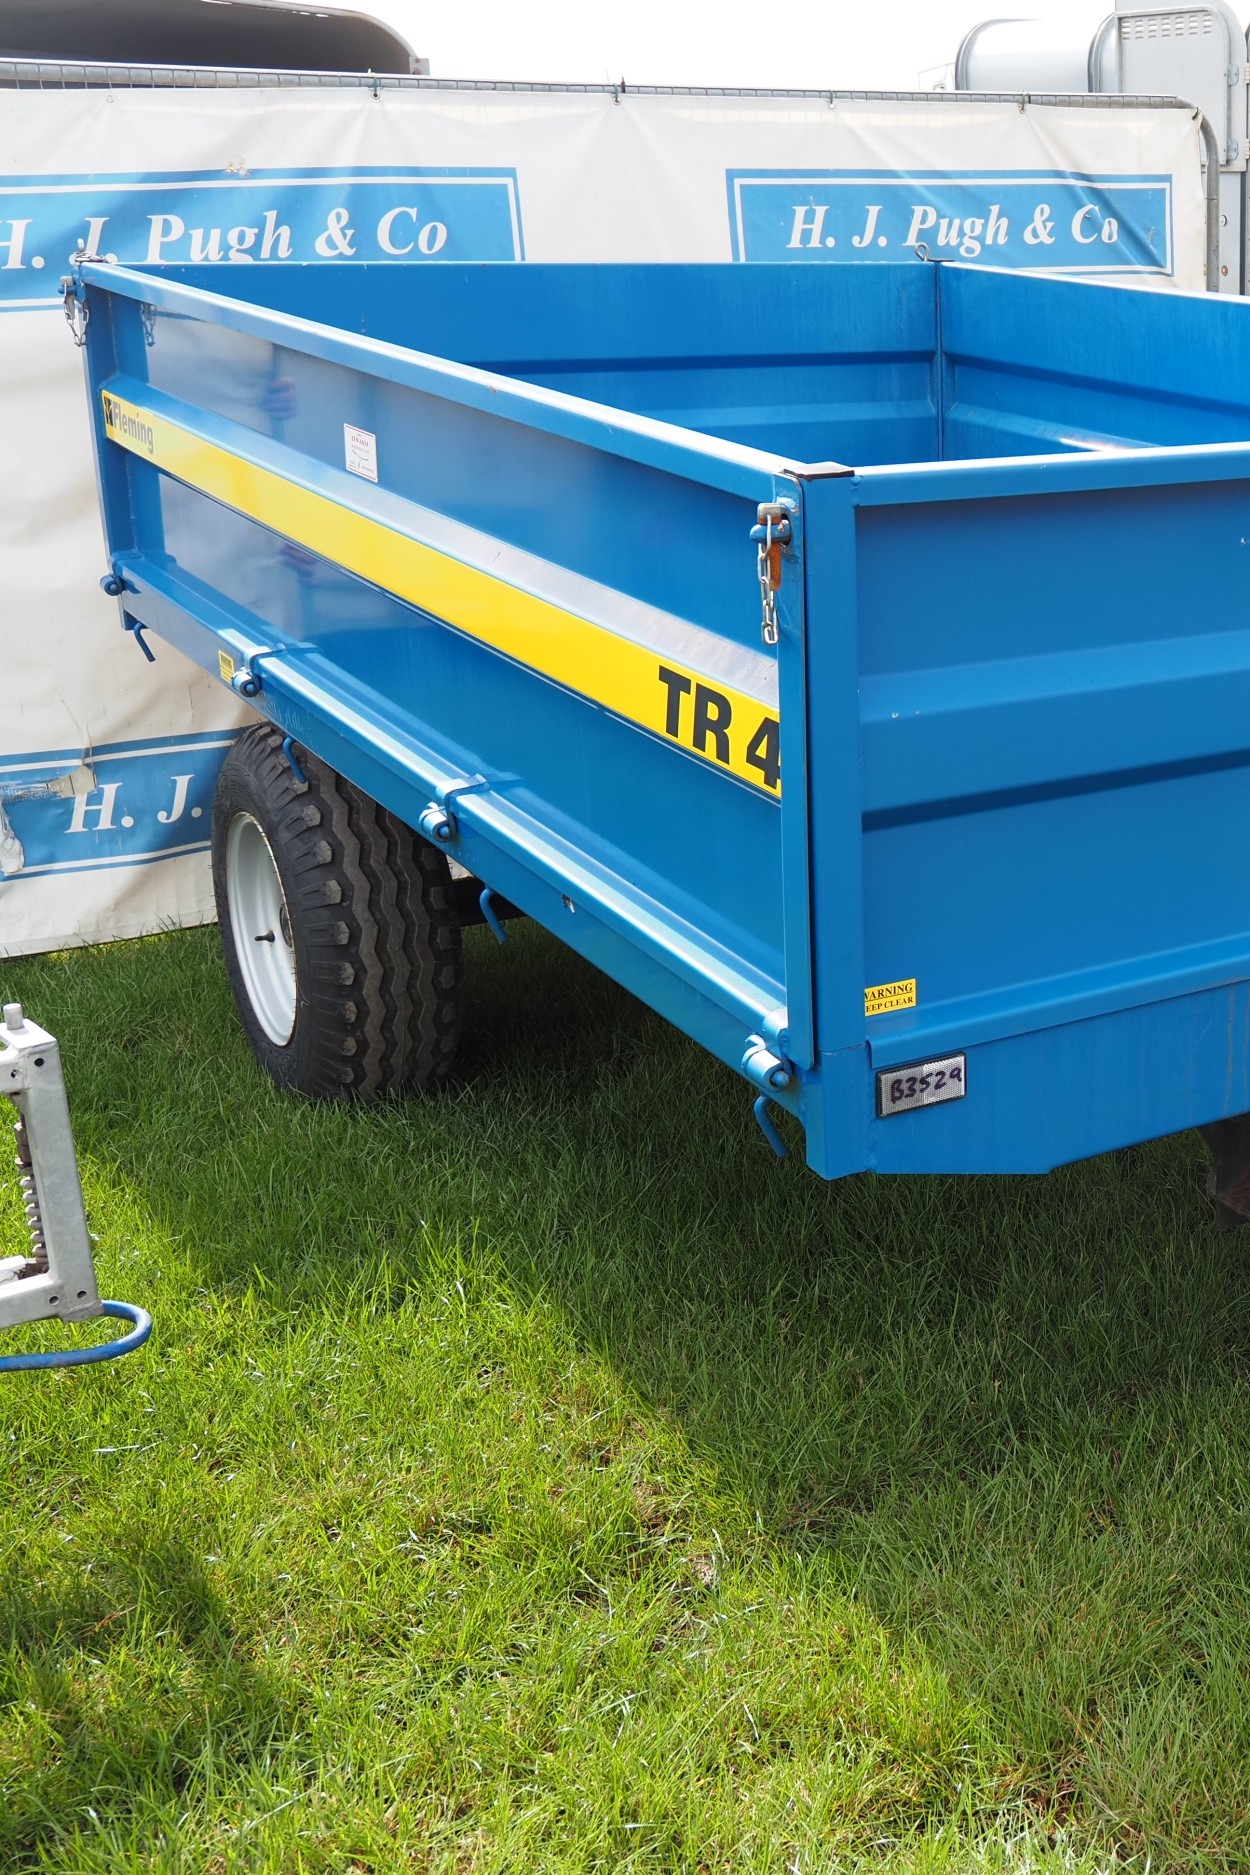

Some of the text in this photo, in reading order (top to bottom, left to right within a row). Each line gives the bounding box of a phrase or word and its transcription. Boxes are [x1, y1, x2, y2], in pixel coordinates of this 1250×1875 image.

[69, 217, 118, 265] J.
[146, 210, 293, 263] Pugh
[314, 206, 356, 258] &
[376, 206, 448, 255] Co
[785, 203, 1119, 258] H. J. Pugh & Co
[112, 402, 155, 455] Fleming
[658, 664, 781, 790] TR 4
[63, 774, 203, 835] H. J.
[865, 996, 914, 1013] EEP CLEAR
